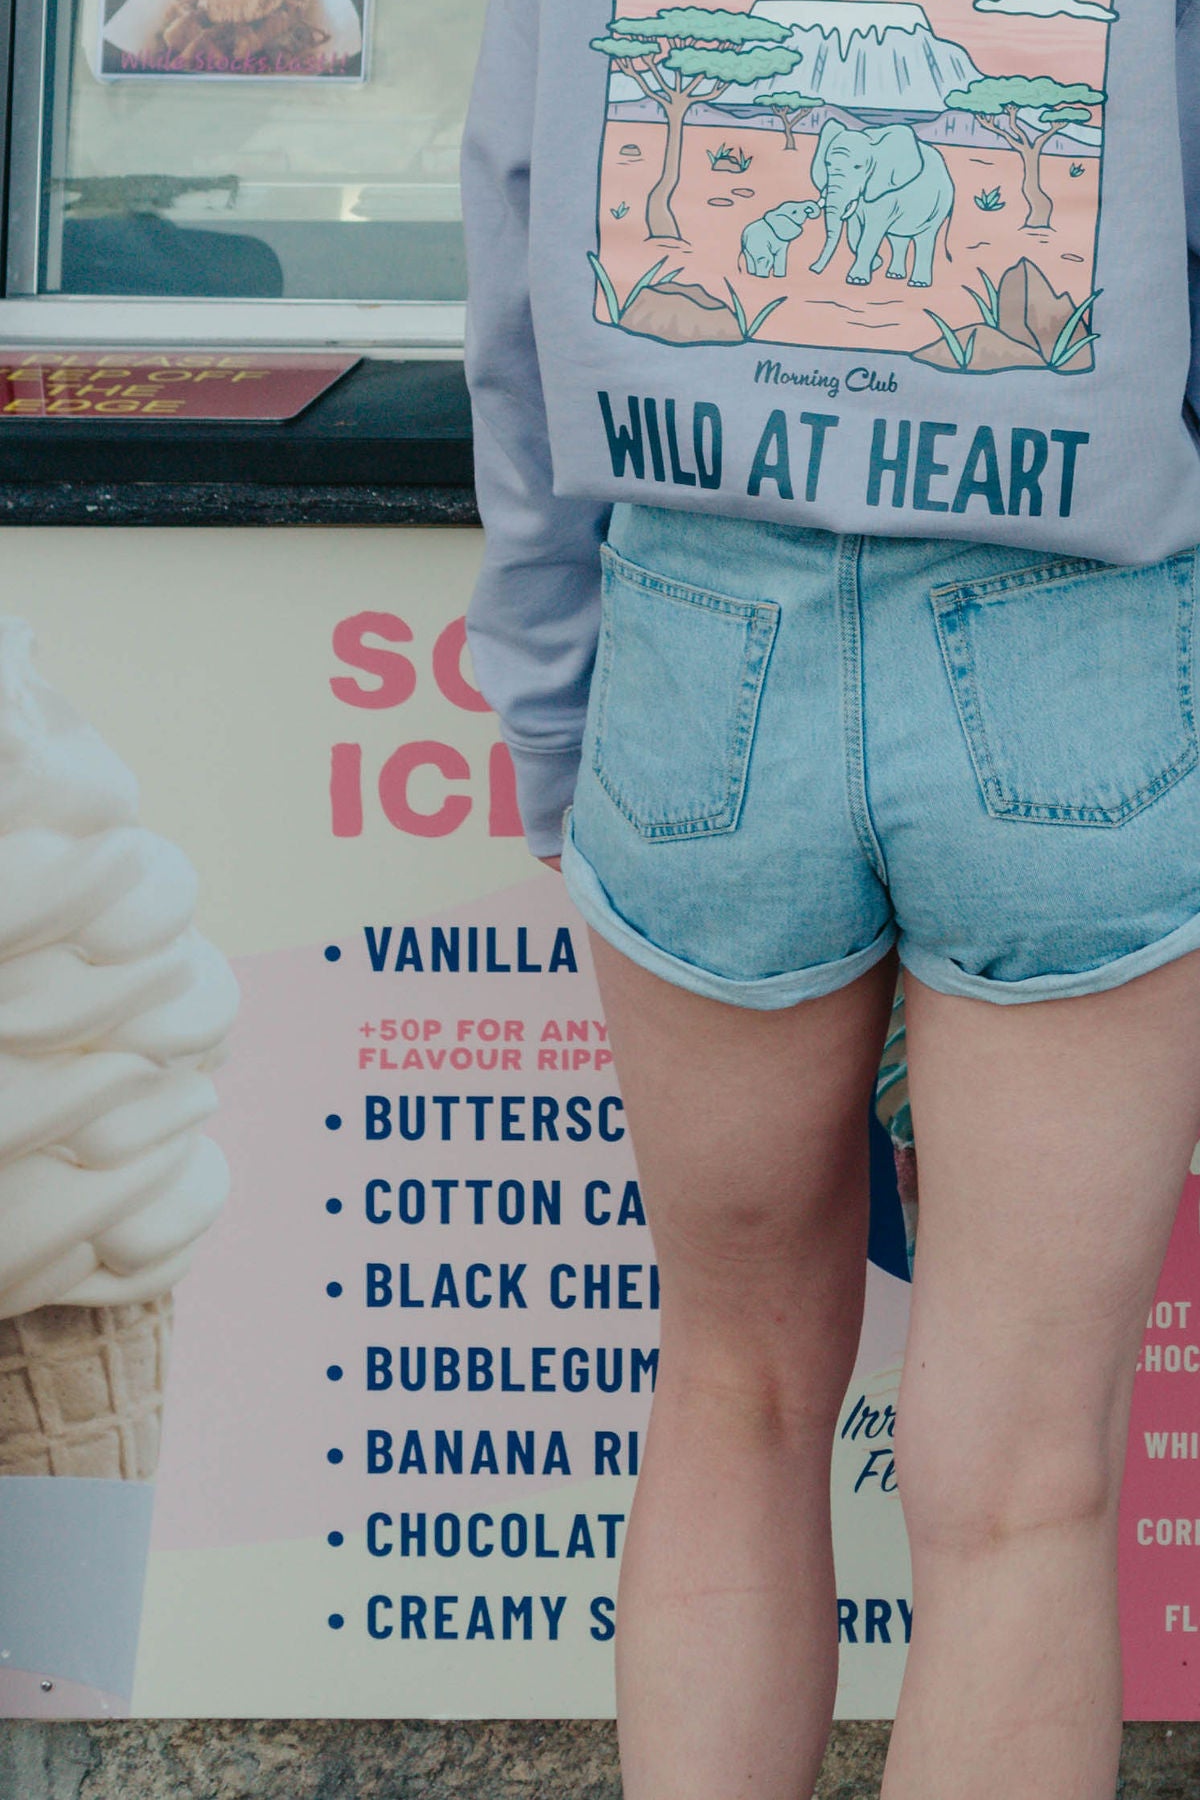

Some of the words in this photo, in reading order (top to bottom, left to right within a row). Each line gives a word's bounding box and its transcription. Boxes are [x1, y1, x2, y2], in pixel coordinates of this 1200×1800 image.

[194, 51, 268, 73] Stocks
[0, 368, 132, 382] EEP
[148, 369, 272, 382] OFF
[22, 353, 256, 367] PLEASE
[46, 384, 166, 397] THE
[753, 360, 840, 398] Morning
[845, 367, 898, 394] Club
[3, 399, 187, 413] EDGE
[597, 390, 722, 490] WILD
[746, 409, 839, 502] AT
[866, 418, 1090, 518] HEART
[364, 926, 578, 973] VANILLA
[359, 1019, 442, 1041] +50P
[457, 1019, 524, 1042] FOR
[358, 1047, 522, 1070] FLAVOUR
[365, 1179, 561, 1226] COTTON
[366, 1262, 527, 1309] BLACK
[1146, 1302, 1191, 1329] OT
[366, 1429, 571, 1475] BANANA
[595, 1431, 638, 1475] RI
[367, 1512, 625, 1558] CHOCOLAT
[367, 1595, 567, 1640] CREAMY
